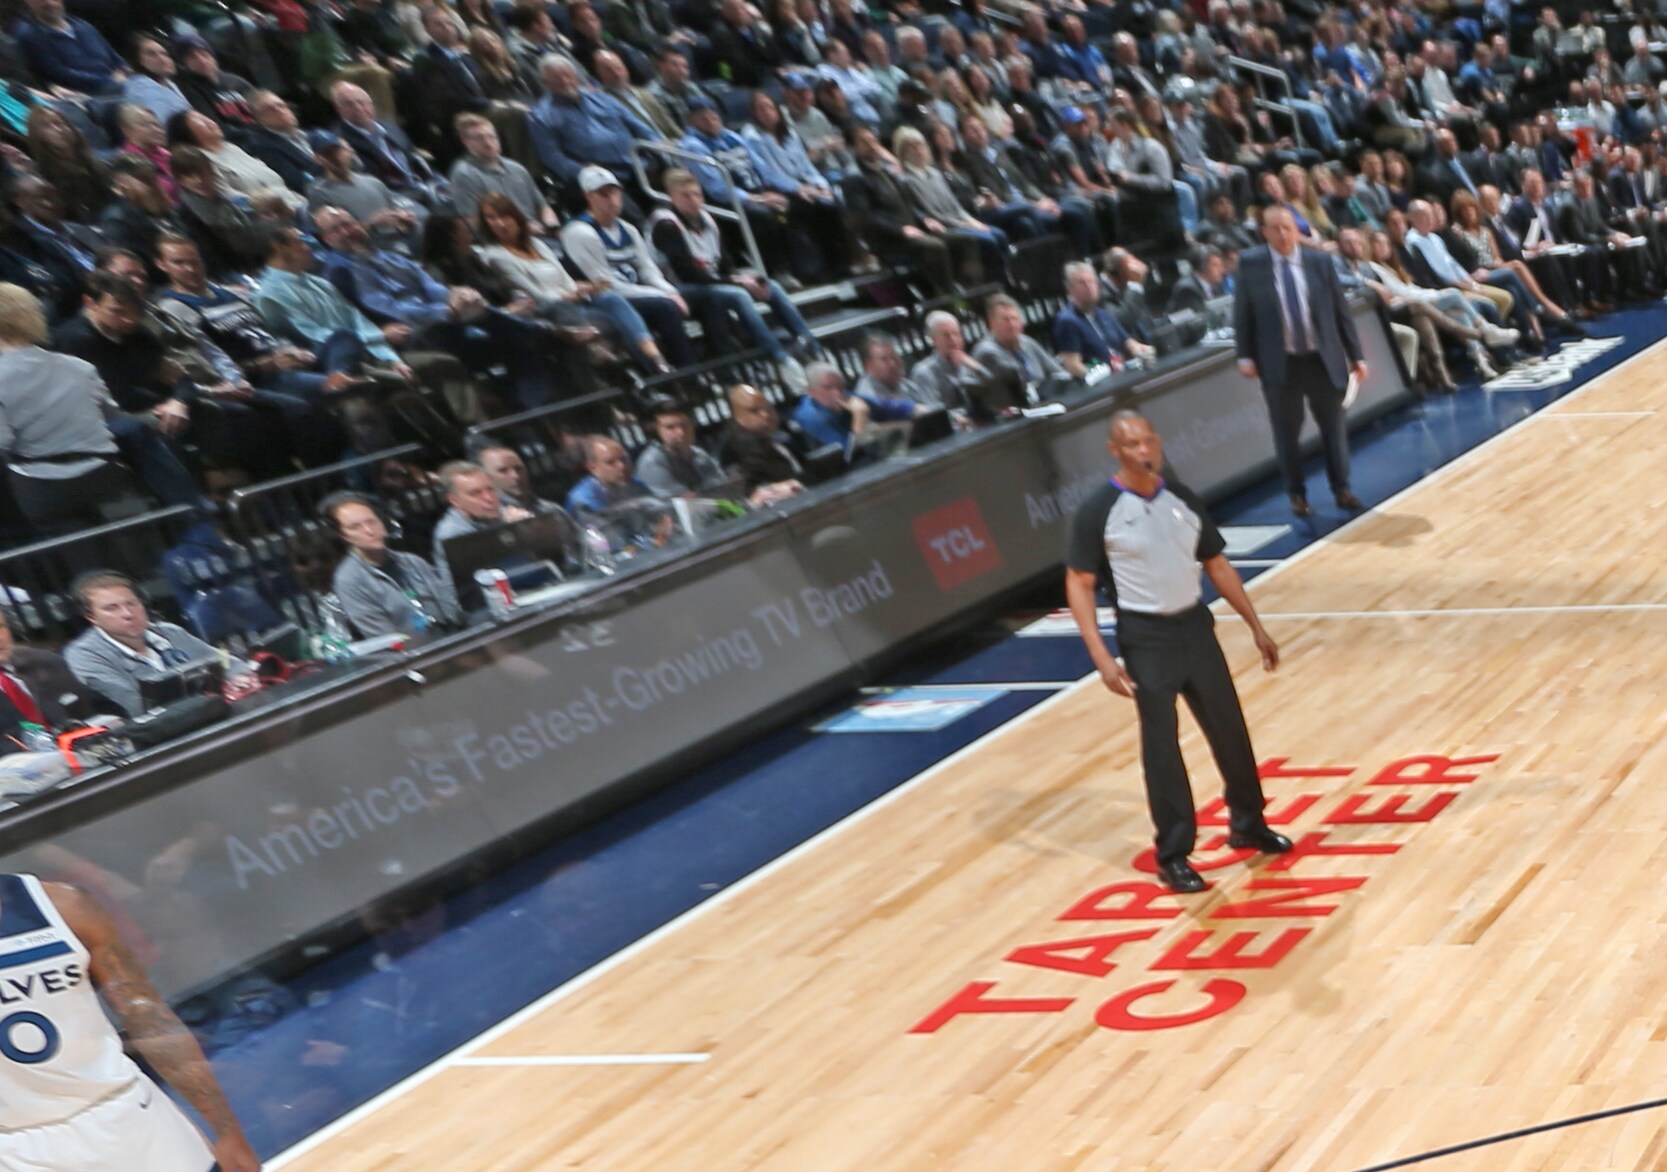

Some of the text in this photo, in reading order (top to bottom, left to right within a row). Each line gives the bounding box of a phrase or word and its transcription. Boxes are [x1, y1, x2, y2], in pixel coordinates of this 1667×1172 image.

[929, 525, 986, 566] TCL
[224, 559, 895, 890] America's Fastest-Growing TV Brand
[1094, 753, 1502, 1032] CENTER
[0, 963, 83, 1005] LVES
[0, 1010, 59, 1065] 0
